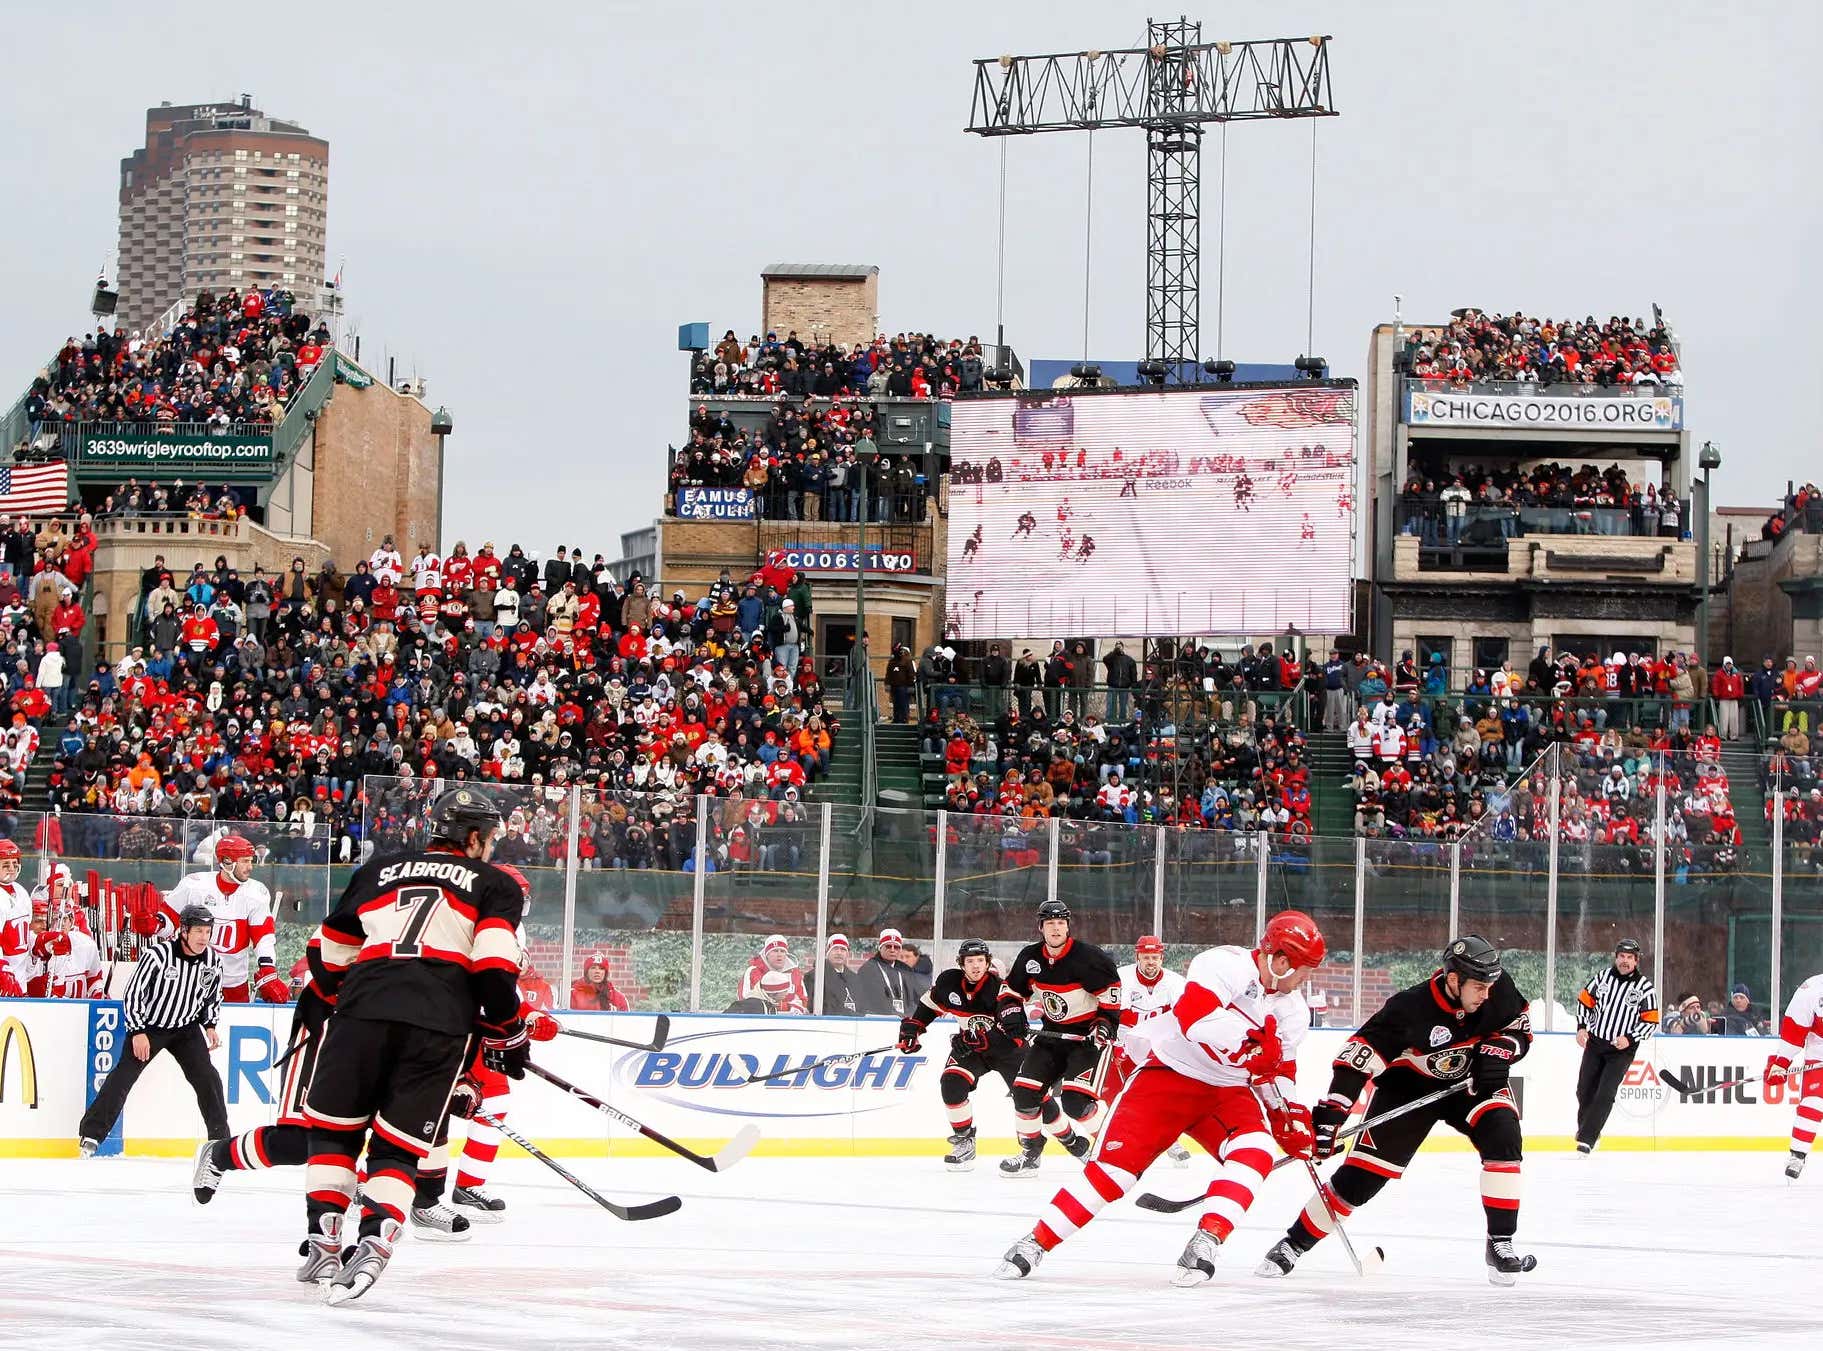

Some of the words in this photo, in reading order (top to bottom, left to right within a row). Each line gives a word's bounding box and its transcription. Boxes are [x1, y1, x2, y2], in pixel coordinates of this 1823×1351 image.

[1431, 400, 1653, 422] CHICAGO2016.ORG
[87, 440, 269, 459] 3639wrigleyrooftop.com
[684, 490, 748, 503] EAMUS
[378, 861, 479, 893] SEABROOK
[391, 886, 446, 957] 7
[1336, 1041, 1374, 1070] 28
[1480, 1044, 1513, 1060] TPS
[635, 1053, 757, 1088] BUD
[765, 1054, 928, 1090] LIGHT
[1622, 1060, 1661, 1086] EA
[1680, 1065, 1757, 1104] NHL
[1620, 1087, 1662, 1100] SPORTS
[599, 1103, 642, 1132] BAUER
